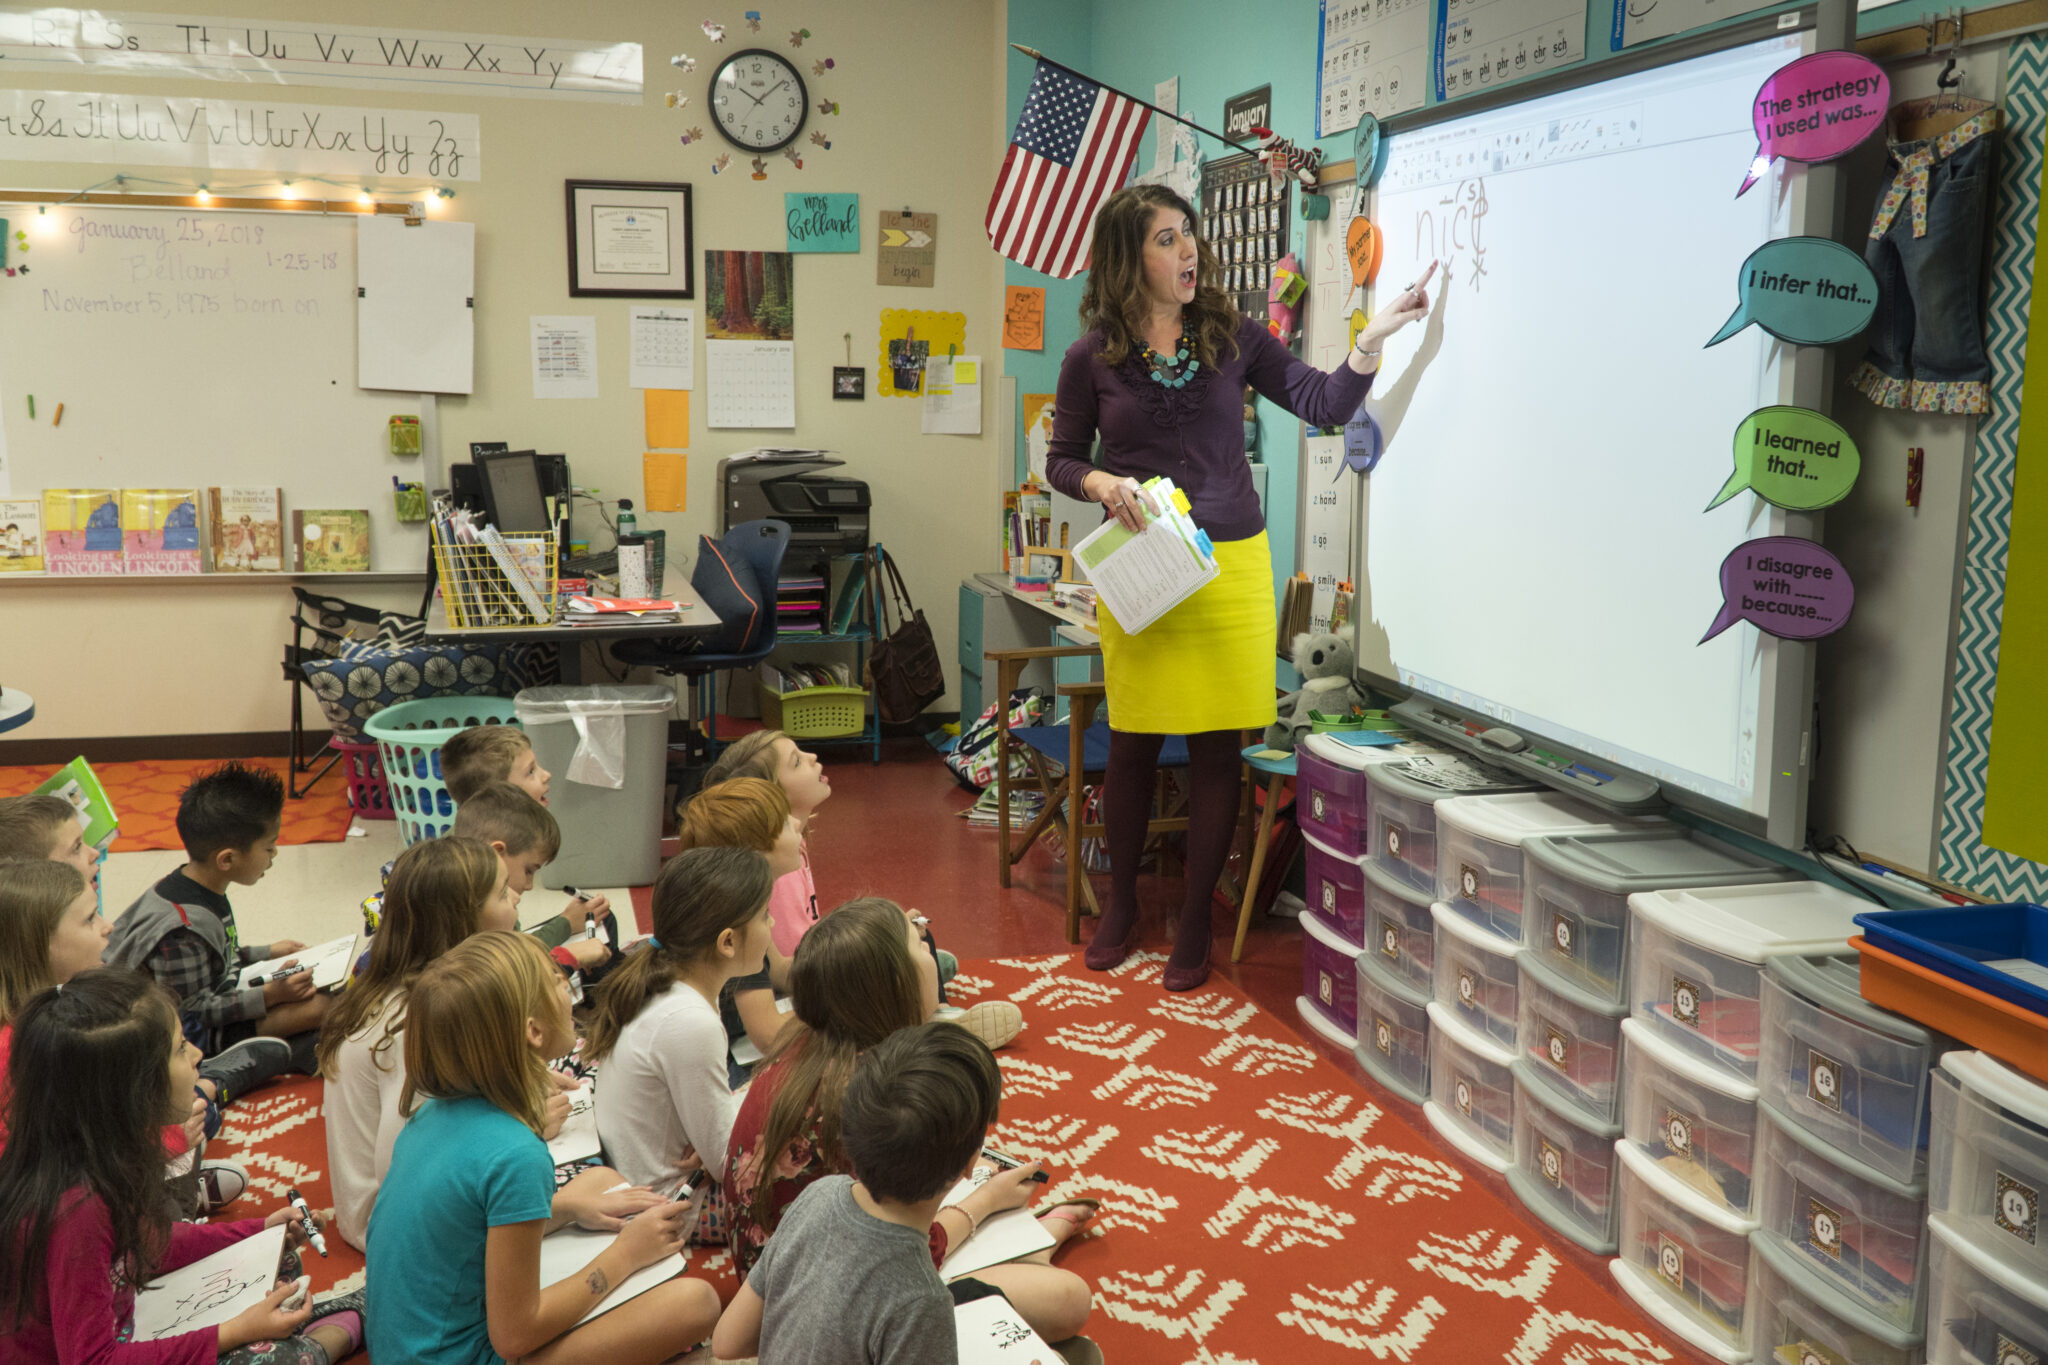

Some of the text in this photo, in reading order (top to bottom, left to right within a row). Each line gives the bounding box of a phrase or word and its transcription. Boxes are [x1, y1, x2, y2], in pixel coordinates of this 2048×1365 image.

[1534, 45, 1546, 58] chr
[1553, 38, 1567, 52] sch
[176, 25, 210, 54] Tt
[247, 29, 286, 59] Uu
[314, 33, 354, 64] Vv
[378, 37, 443, 68] Ww
[464, 43, 500, 72] Xx
[523, 47, 562, 89] Yy
[752, 64, 762, 73] 12
[783, 81, 790, 91] 2
[788, 98, 795, 108] 3
[1761, 74, 1881, 118] The strategy
[727, 113, 734, 123] 8
[784, 114, 791, 124] 4
[1227, 102, 1268, 133] January
[1776, 116, 1820, 139] used
[1824, 106, 1877, 128] was...
[741, 125, 748, 134] 7
[756, 130, 763, 140] 6
[772, 126, 780, 136] 5
[787, 203, 856, 243] Belland
[266, 252, 338, 270] 1-25-18
[1749, 270, 1871, 304] I infer that...
[43, 288, 141, 313] November
[1755, 428, 1841, 458] I learned
[1320, 456, 1332, 464] sun
[1767, 455, 1818, 481] that...
[1320, 494, 1336, 505] hand
[1318, 536, 1327, 548] go
[49, 562, 123, 574] LINCOLN
[125, 562, 200, 574] LINCOLN
[1757, 557, 1833, 580] disagree
[1318, 573, 1336, 585] smile
[1753, 578, 1790, 595] with
[1557, 928, 1566, 941] 10
[1680, 994, 1689, 1008] 13
[1552, 1042, 1561, 1056] 11
[1817, 1072, 1828, 1088] 16
[1672, 1126, 1682, 1138] 14
[2008, 1198, 2021, 1216] 19
[1816, 1219, 1828, 1234] 17
